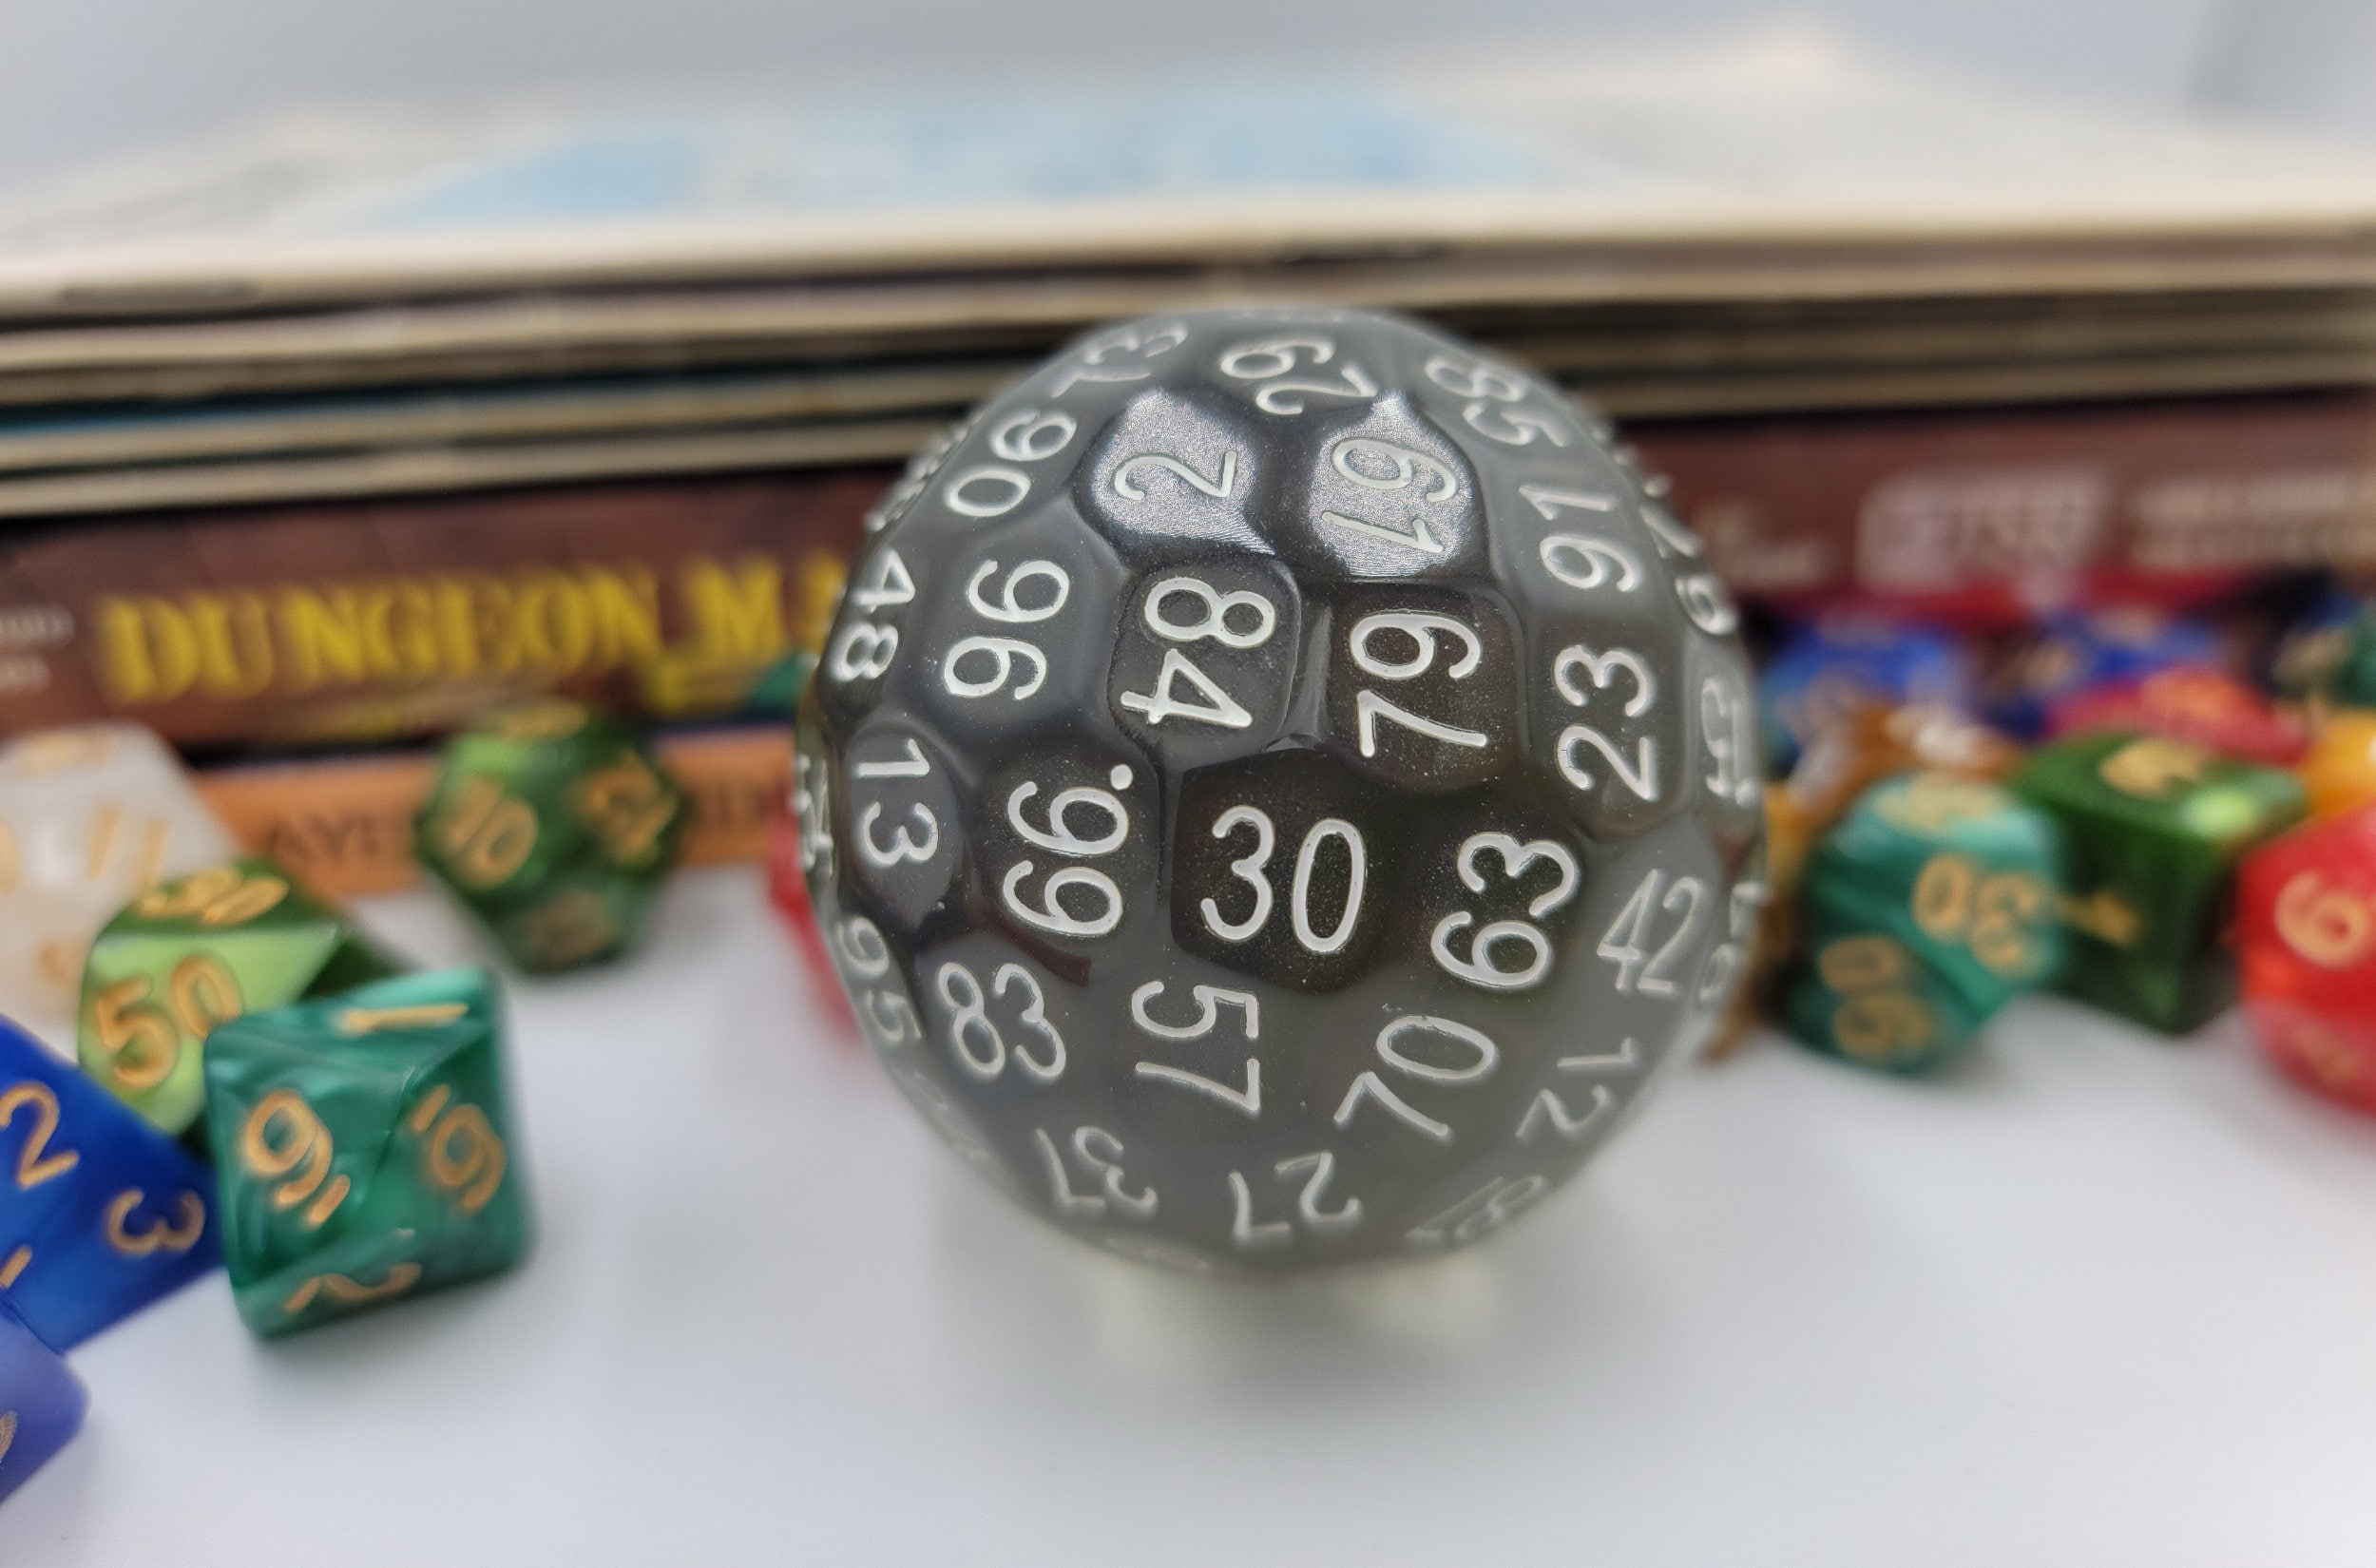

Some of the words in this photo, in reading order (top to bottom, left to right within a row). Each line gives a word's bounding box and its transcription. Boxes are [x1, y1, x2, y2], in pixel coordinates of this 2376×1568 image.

[1114, 450, 1237, 503] 2
[1321, 436, 1458, 554] 61
[1519, 486, 1643, 593] 91
[830, 548, 915, 682] 48
[943, 559, 1070, 701] 96
[1121, 577, 1276, 730] 84
[1349, 609, 1488, 757] 79
[1554, 643, 1657, 801] 23
[858, 738, 939, 867] 13
[1200, 805, 1367, 953] 30
[1430, 831, 1581, 990] 63
[1597, 869, 1703, 992] 42
[97, 954, 245, 1087] 50
[938, 962, 1066, 1079] 83
[1131, 980, 1260, 1114] 57
[1333, 1015, 1501, 1138] 70
[105, 1187, 206, 1256] 3
[1035, 1126, 1157, 1209] 37
[1230, 1152, 1363, 1240] 27
